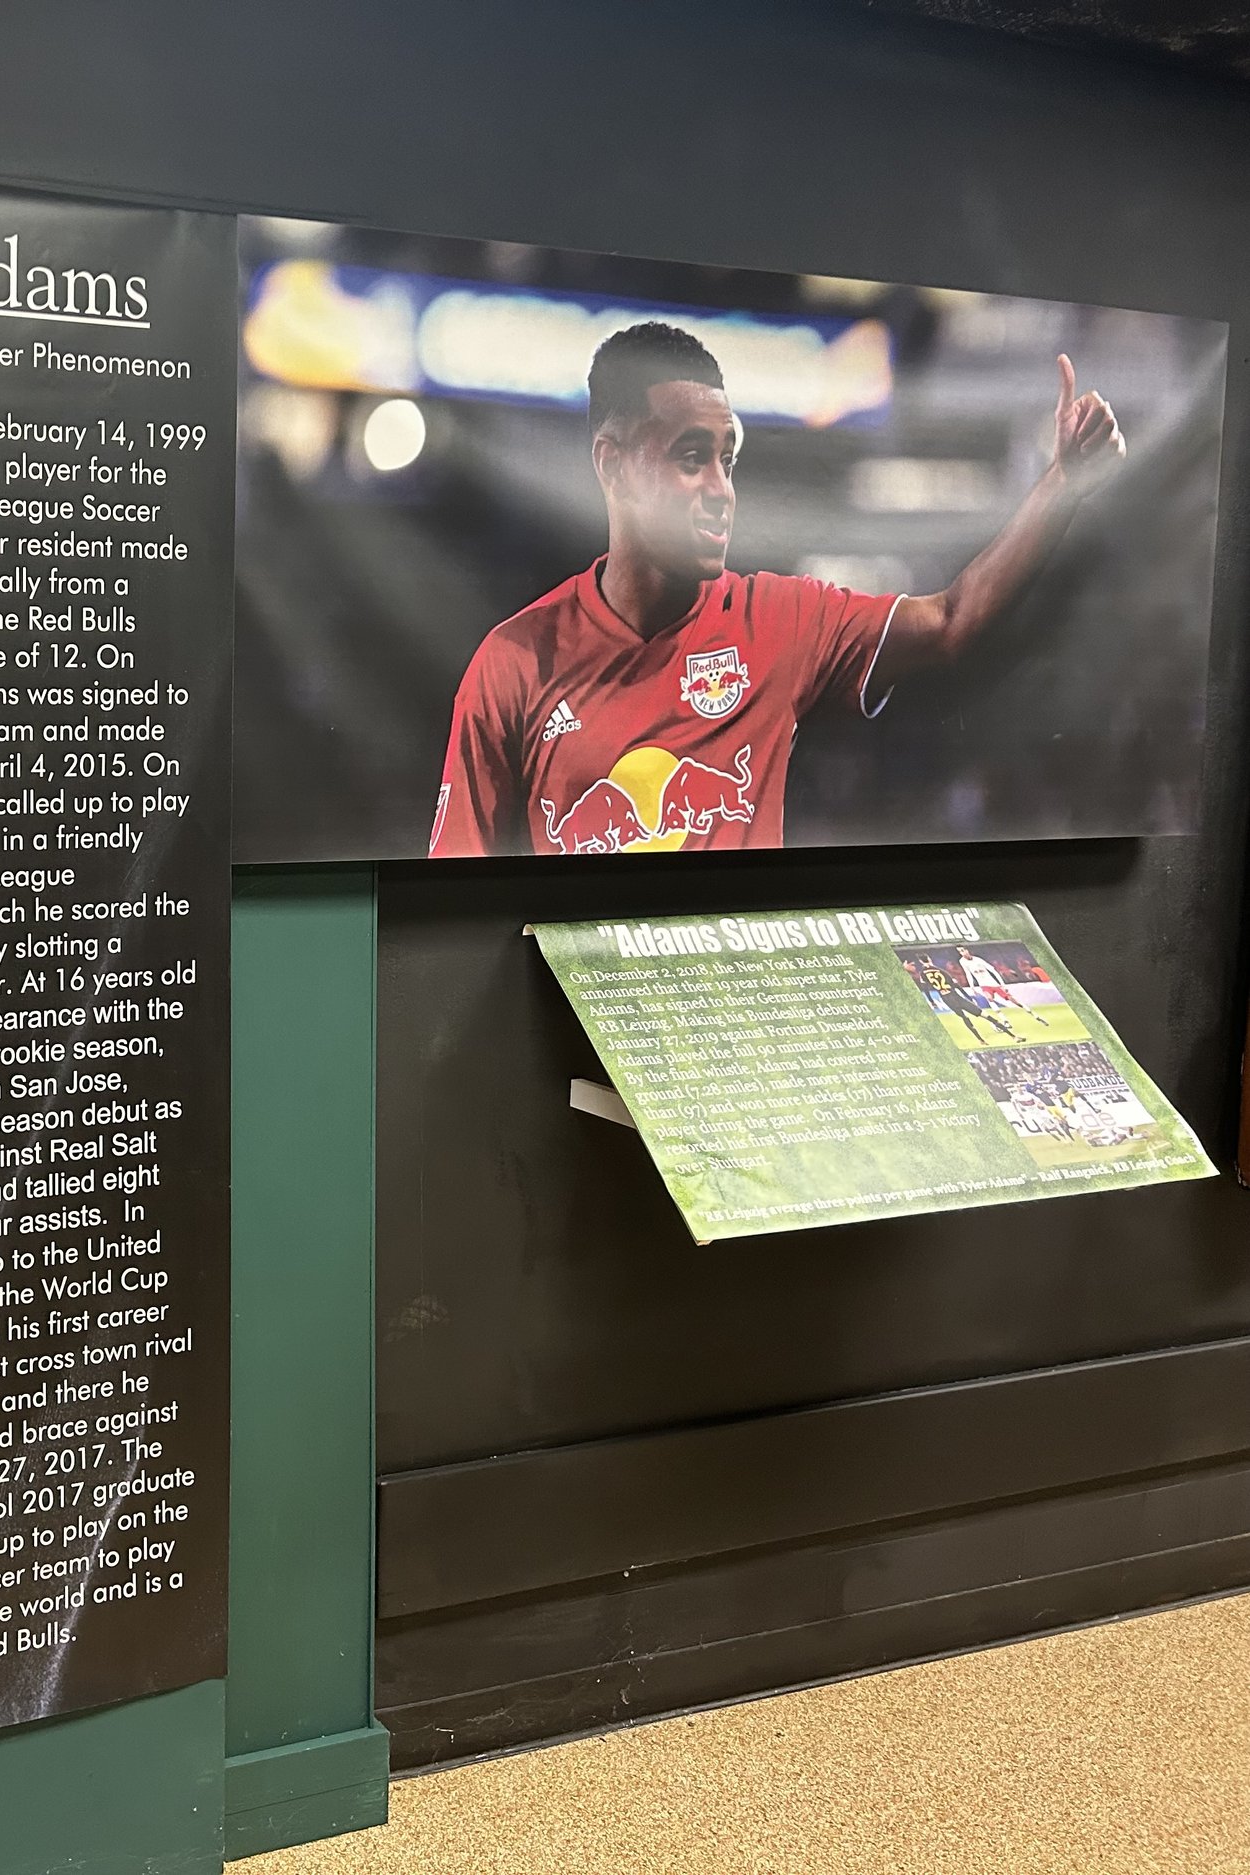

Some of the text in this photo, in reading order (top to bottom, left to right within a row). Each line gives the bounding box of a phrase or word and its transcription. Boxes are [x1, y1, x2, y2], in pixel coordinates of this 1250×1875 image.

[32, 344, 192, 379] Phenomenon
[97, 420, 135, 452] 14,
[146, 421, 207, 452] 1999
[5, 452, 82, 487] player
[88, 455, 123, 484] for
[129, 458, 167, 486] the
[82, 494, 161, 523] Soccer
[18, 530, 113, 558] resident
[121, 533, 188, 561] made
[699, 690, 736, 711] NEW YORK
[42, 715, 89, 742] and
[98, 715, 165, 742] made
[35, 896, 64, 922] he
[71, 892, 147, 921] scored
[154, 891, 190, 917] the
[597, 908, 980, 958] "Adams Signs to RB Leipzig"
[570, 953, 854, 984] On December 2, 2018, the New York Red Bulls
[926, 971, 951, 991] 52
[579, 969, 878, 1001] announced that their 19 year old super star, Tyler
[72, 1036, 164, 1060] season,
[726, 1205, 769, 1221] Leipzig
[770, 1201, 813, 1216] average
[814, 1198, 850, 1210] three
[848, 1192, 883, 1208] points
[884, 1190, 903, 1205] per
[905, 1187, 933, 1202] game
[934, 1181, 958, 1195] with
[957, 1179, 988, 1194] Tyler
[1038, 1167, 1063, 1182] Ralf
[1063, 1163, 1114, 1180] Rangnick,
[1114, 1160, 1130, 1173] RB
[1129, 1157, 1167, 1172] Leipzig
[1166, 1153, 1196, 1167] Coach
[15, 1351, 76, 1375] cross
[81, 1343, 137, 1366] town
[145, 1327, 192, 1357] rival
[17, 1621, 77, 1651] Bulls.
